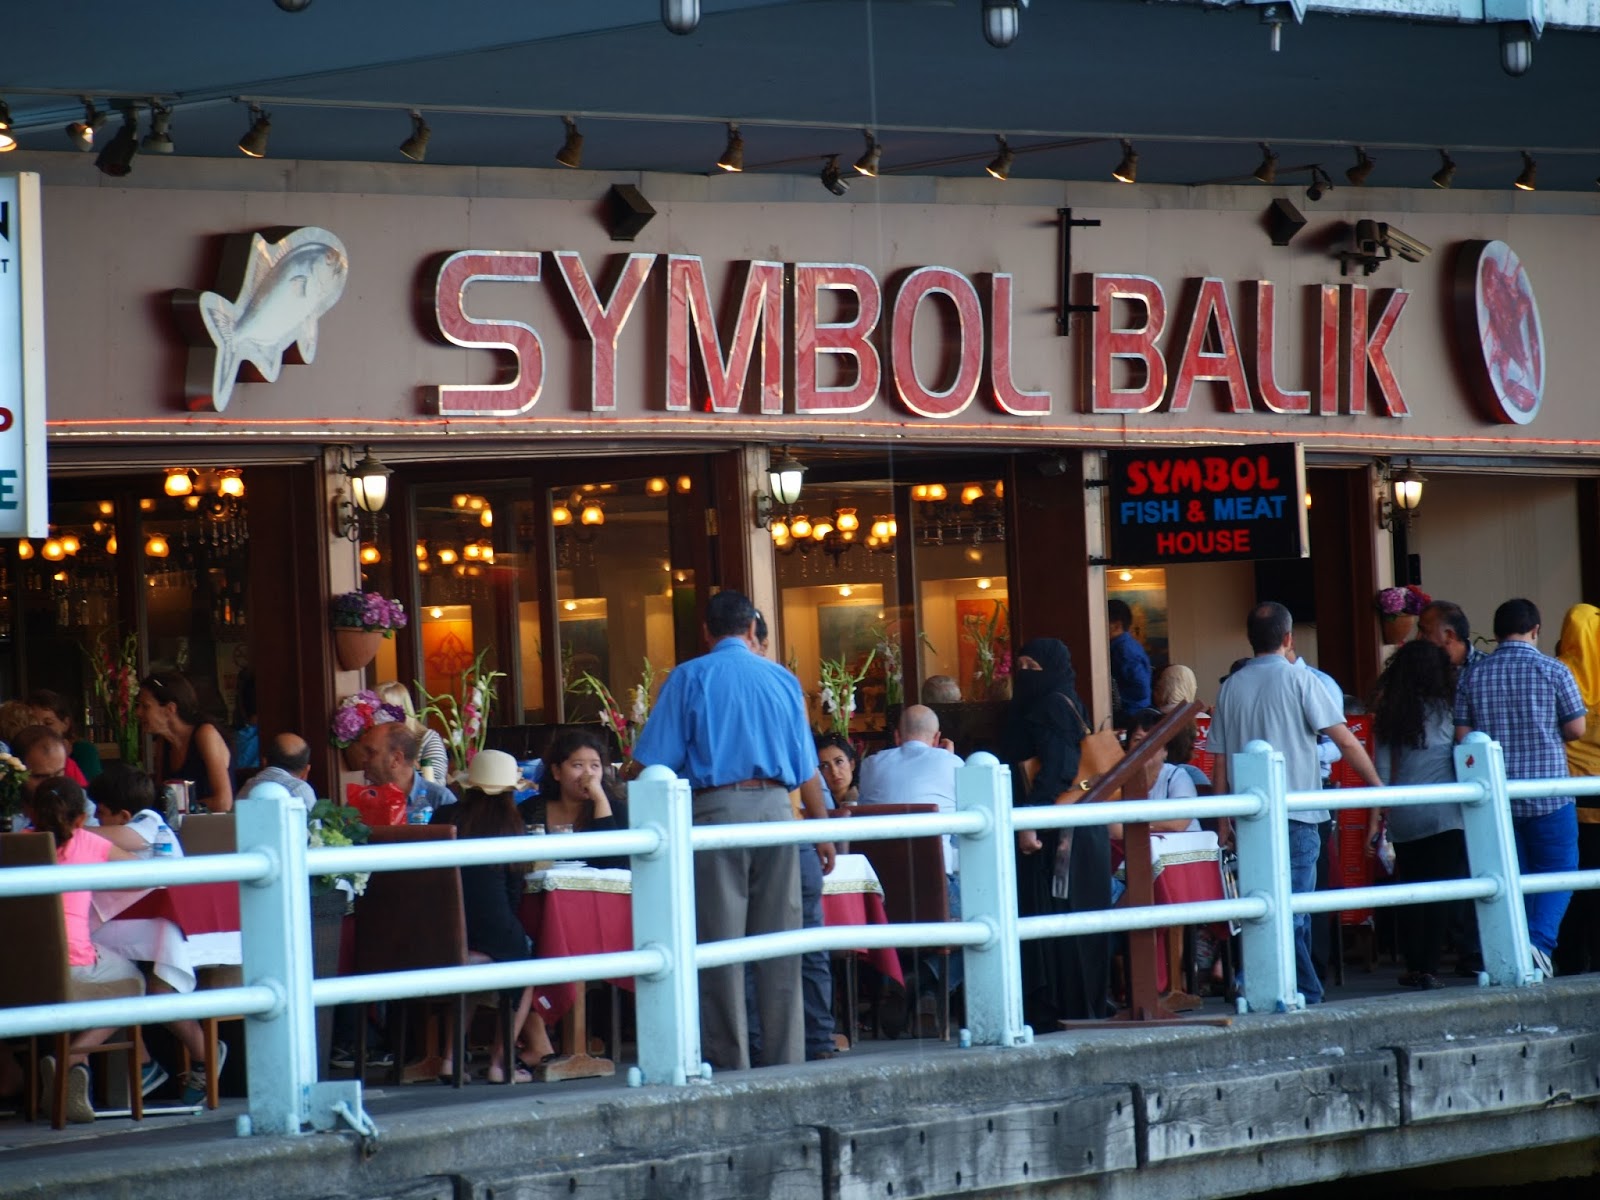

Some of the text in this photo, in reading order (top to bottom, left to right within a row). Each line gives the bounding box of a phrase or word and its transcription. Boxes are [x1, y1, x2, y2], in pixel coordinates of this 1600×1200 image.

[435, 249, 1413, 418] SYMBOL BALIK
[1126, 455, 1280, 496] SYMBOL
[1120, 495, 1288, 525] FISH & MEAT
[1156, 529, 1251, 555] HOUSE
